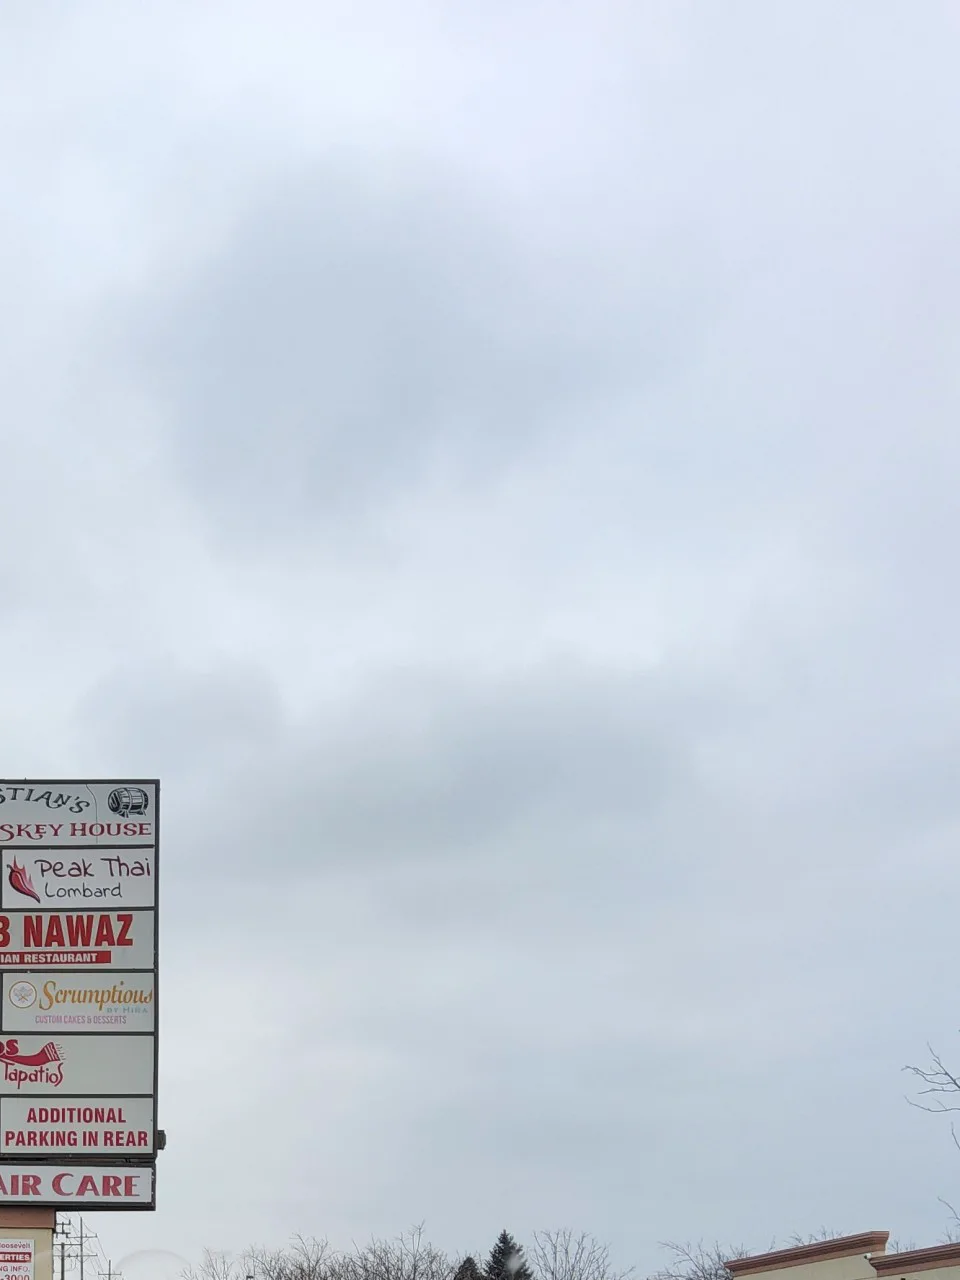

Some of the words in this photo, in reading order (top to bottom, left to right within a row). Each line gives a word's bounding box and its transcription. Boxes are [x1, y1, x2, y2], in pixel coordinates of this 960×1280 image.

[69, 821, 152, 838] HOUSE
[34, 858, 95, 879] Peak
[100, 857, 151, 878] Thai
[44, 882, 123, 899] Lombard
[23, 913, 134, 948] NAWAZ
[23, 953, 98, 963] RESTAURANT
[39, 980, 153, 1011] Scrumptious
[35, 1015, 62, 1025] CUSTOM
[64, 1015, 86, 1025] CAKES
[93, 1015, 127, 1025] DESSERTS
[0, 1058, 64, 1090] Tapatios
[26, 1107, 127, 1124] ADDITIONAL
[4, 1130, 78, 1148] PARKING
[82, 1130, 99, 1147] IN
[103, 1130, 149, 1147] REAR
[51, 1172, 141, 1197] CARE
